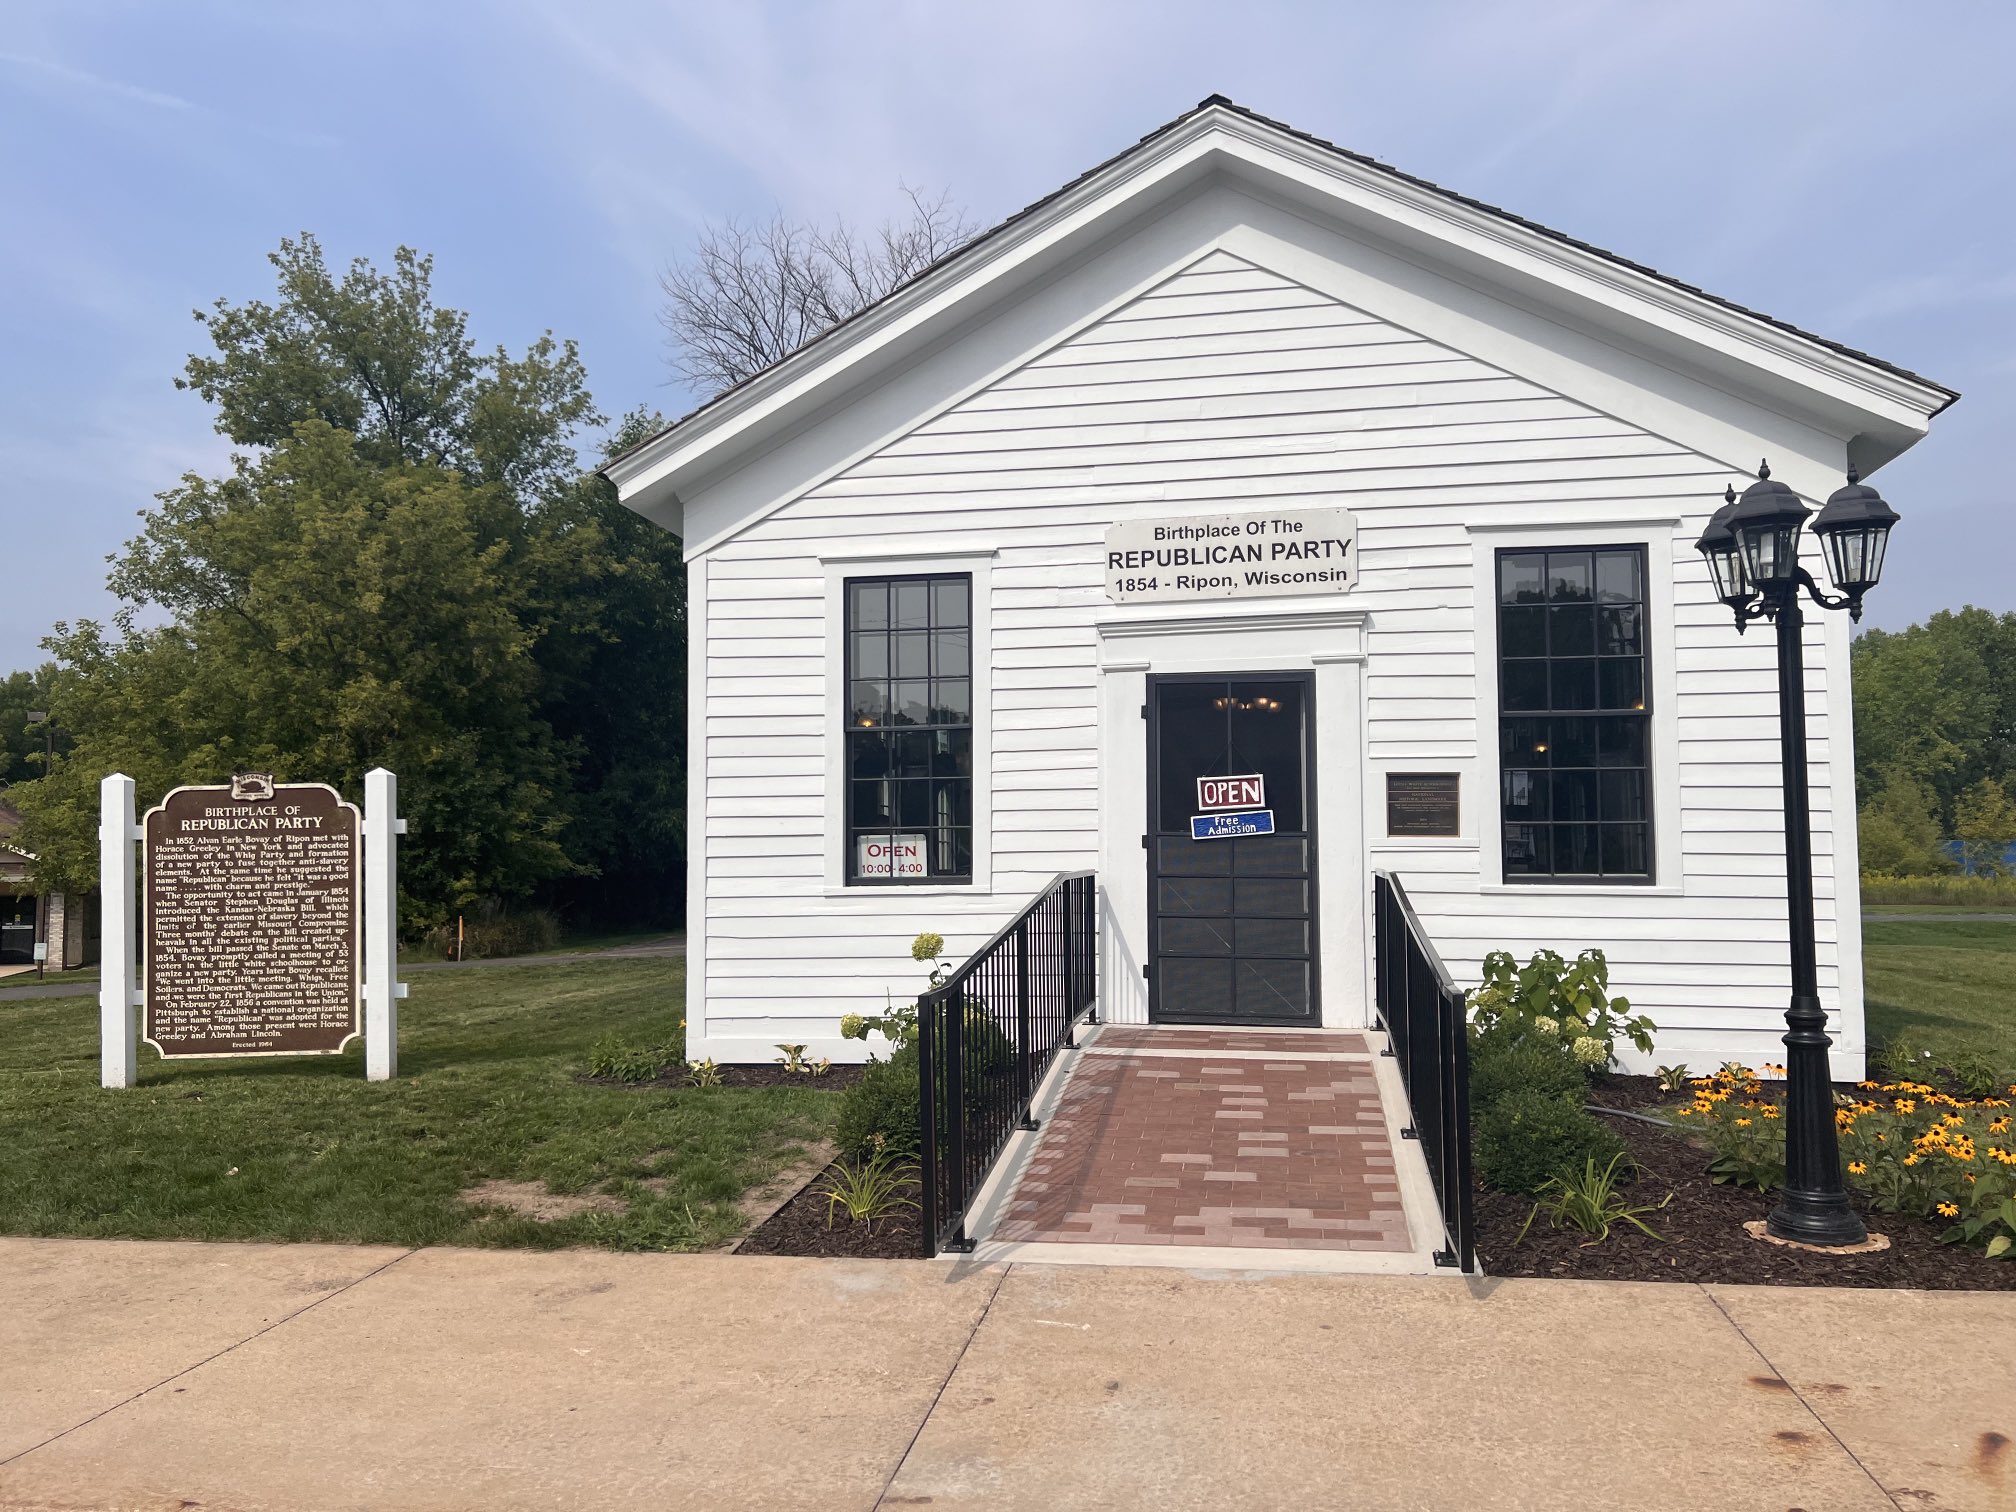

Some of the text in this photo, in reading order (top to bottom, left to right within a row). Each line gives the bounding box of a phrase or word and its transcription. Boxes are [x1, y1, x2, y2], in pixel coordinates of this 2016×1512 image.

[1154, 519, 1303, 541] Birthplace Of The
[1108, 538, 1352, 570] REPUBLICAN PARTY
[1115, 577, 1158, 592] 1854
[1177, 574, 1238, 591] Ripon,
[1245, 568, 1347, 586] Wisconsin
[1204, 780, 1260, 804] OPEN
[205, 805, 301, 817] BIRTHPLACE OF
[181, 816, 323, 831] REPUBLICAN PARTY
[1214, 817, 1239, 826] Free
[1207, 824, 1257, 836] Admission
[246, 836, 270, 844] Bovay
[189, 845, 221, 853] Greeley
[235, 852, 256, 860] Whig
[259, 859, 296, 867] together
[299, 858, 349, 866] anti-slavery
[291, 866, 332, 874] suggested
[862, 864, 891, 873] 10:00
[898, 863, 923, 873] 4:00
[183, 891, 234, 900] opportunity
[296, 889, 330, 897] January
[266, 898, 298, 906] Douglas
[156, 915, 196, 923] permitted
[270, 913, 298, 921] slavery
[302, 913, 332, 921] beyond
[299, 920, 349, 928] Compromise.
[234, 937, 269, 945] existing
[312, 936, 343, 944] parties.
[226, 945, 253, 953] passed
[181, 954, 207, 962] Bovay
[211, 953, 250, 961] promptly
[289, 952, 322, 960] meeting
[155, 970, 183, 978] ganize
[288, 967, 313, 975] Bovay
[202, 984, 248, 992] Democrats.
[246, 991, 292, 999] Republicans
[180, 1000, 218, 1008] February
[155, 1009, 199, 1017] Pittsburgh
[296, 1006, 349, 1014] organization
[286, 1014, 317, 1022] adopted
[206, 1024, 235, 1032] Among
[265, 1022, 296, 1030] present
